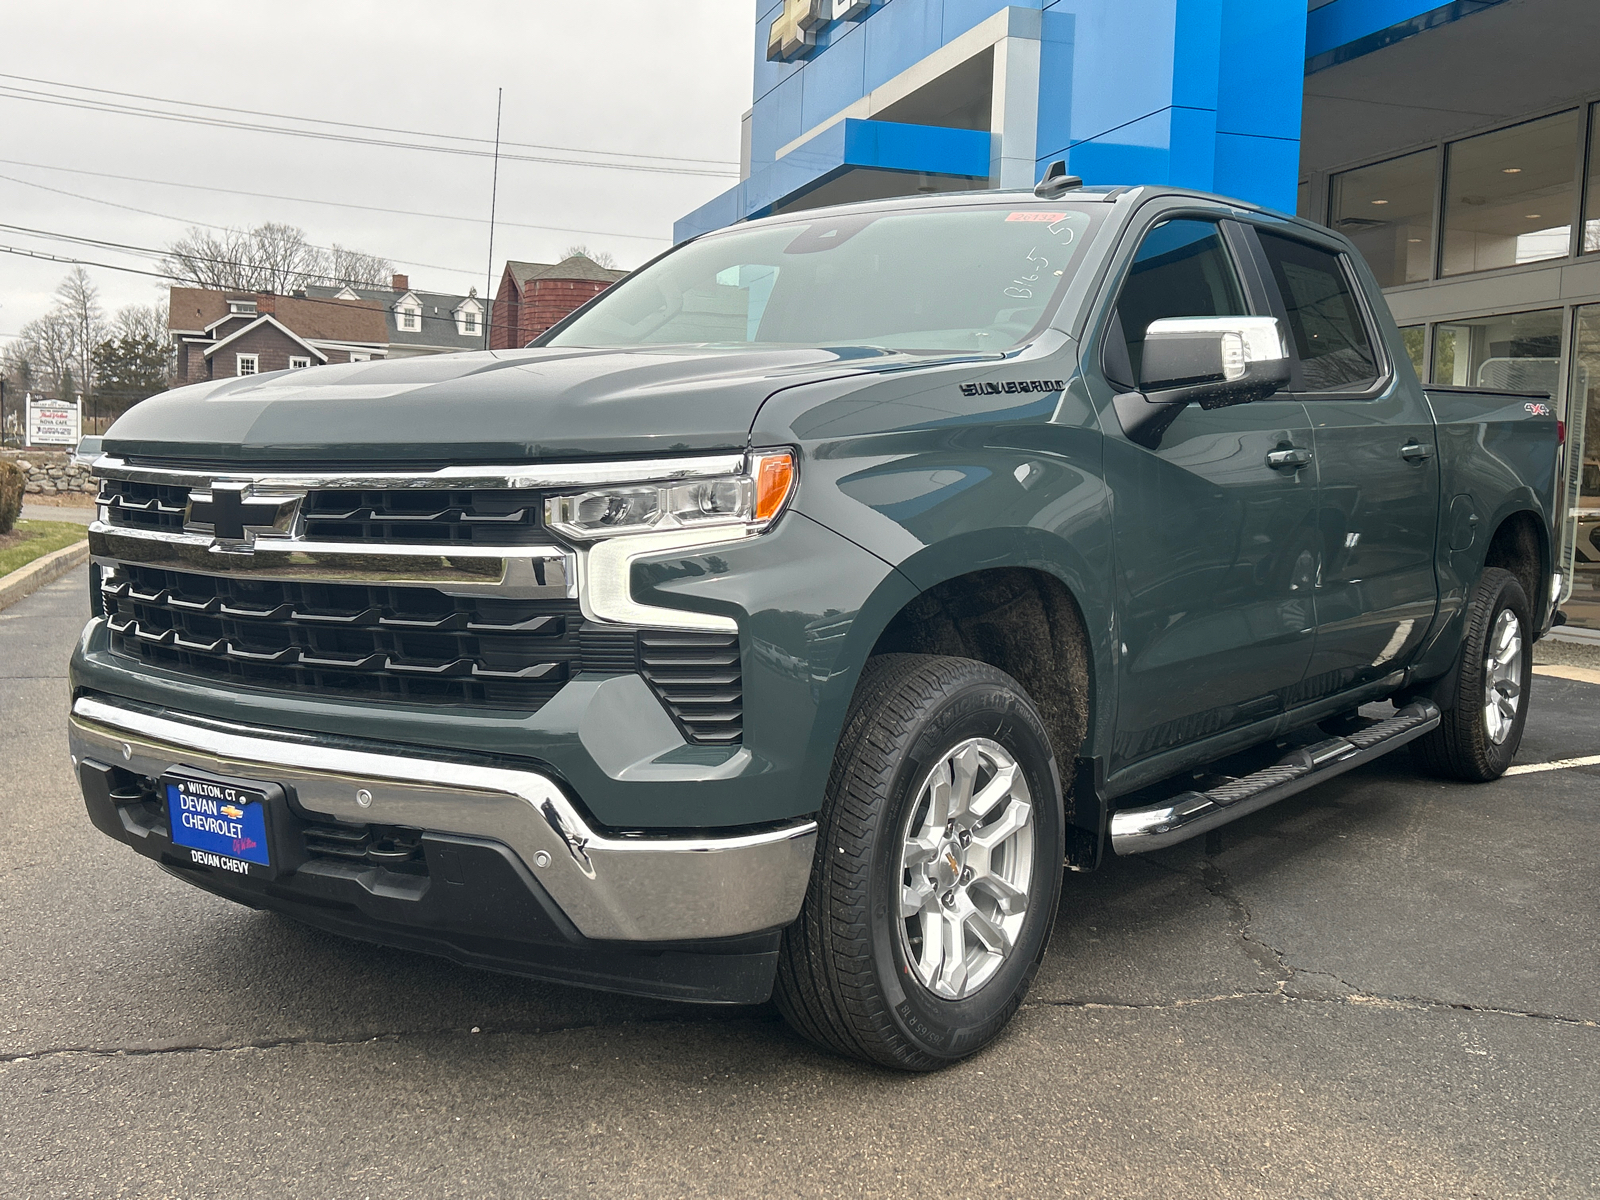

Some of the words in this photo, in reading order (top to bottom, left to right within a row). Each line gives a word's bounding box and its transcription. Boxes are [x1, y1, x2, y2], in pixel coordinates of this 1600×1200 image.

[1013, 213, 1056, 221] 26132
[959, 380, 1065, 396] SILVERADO
[1015, 702, 1042, 735] PRIMACY
[187, 782, 223, 799] WILTON,
[225, 789, 236, 801] CT
[180, 795, 217, 815] DEVAN
[182, 813, 242, 838] CHEVROLET
[191, 850, 220, 867] DEVAN
[221, 857, 249, 875] CHEVY
